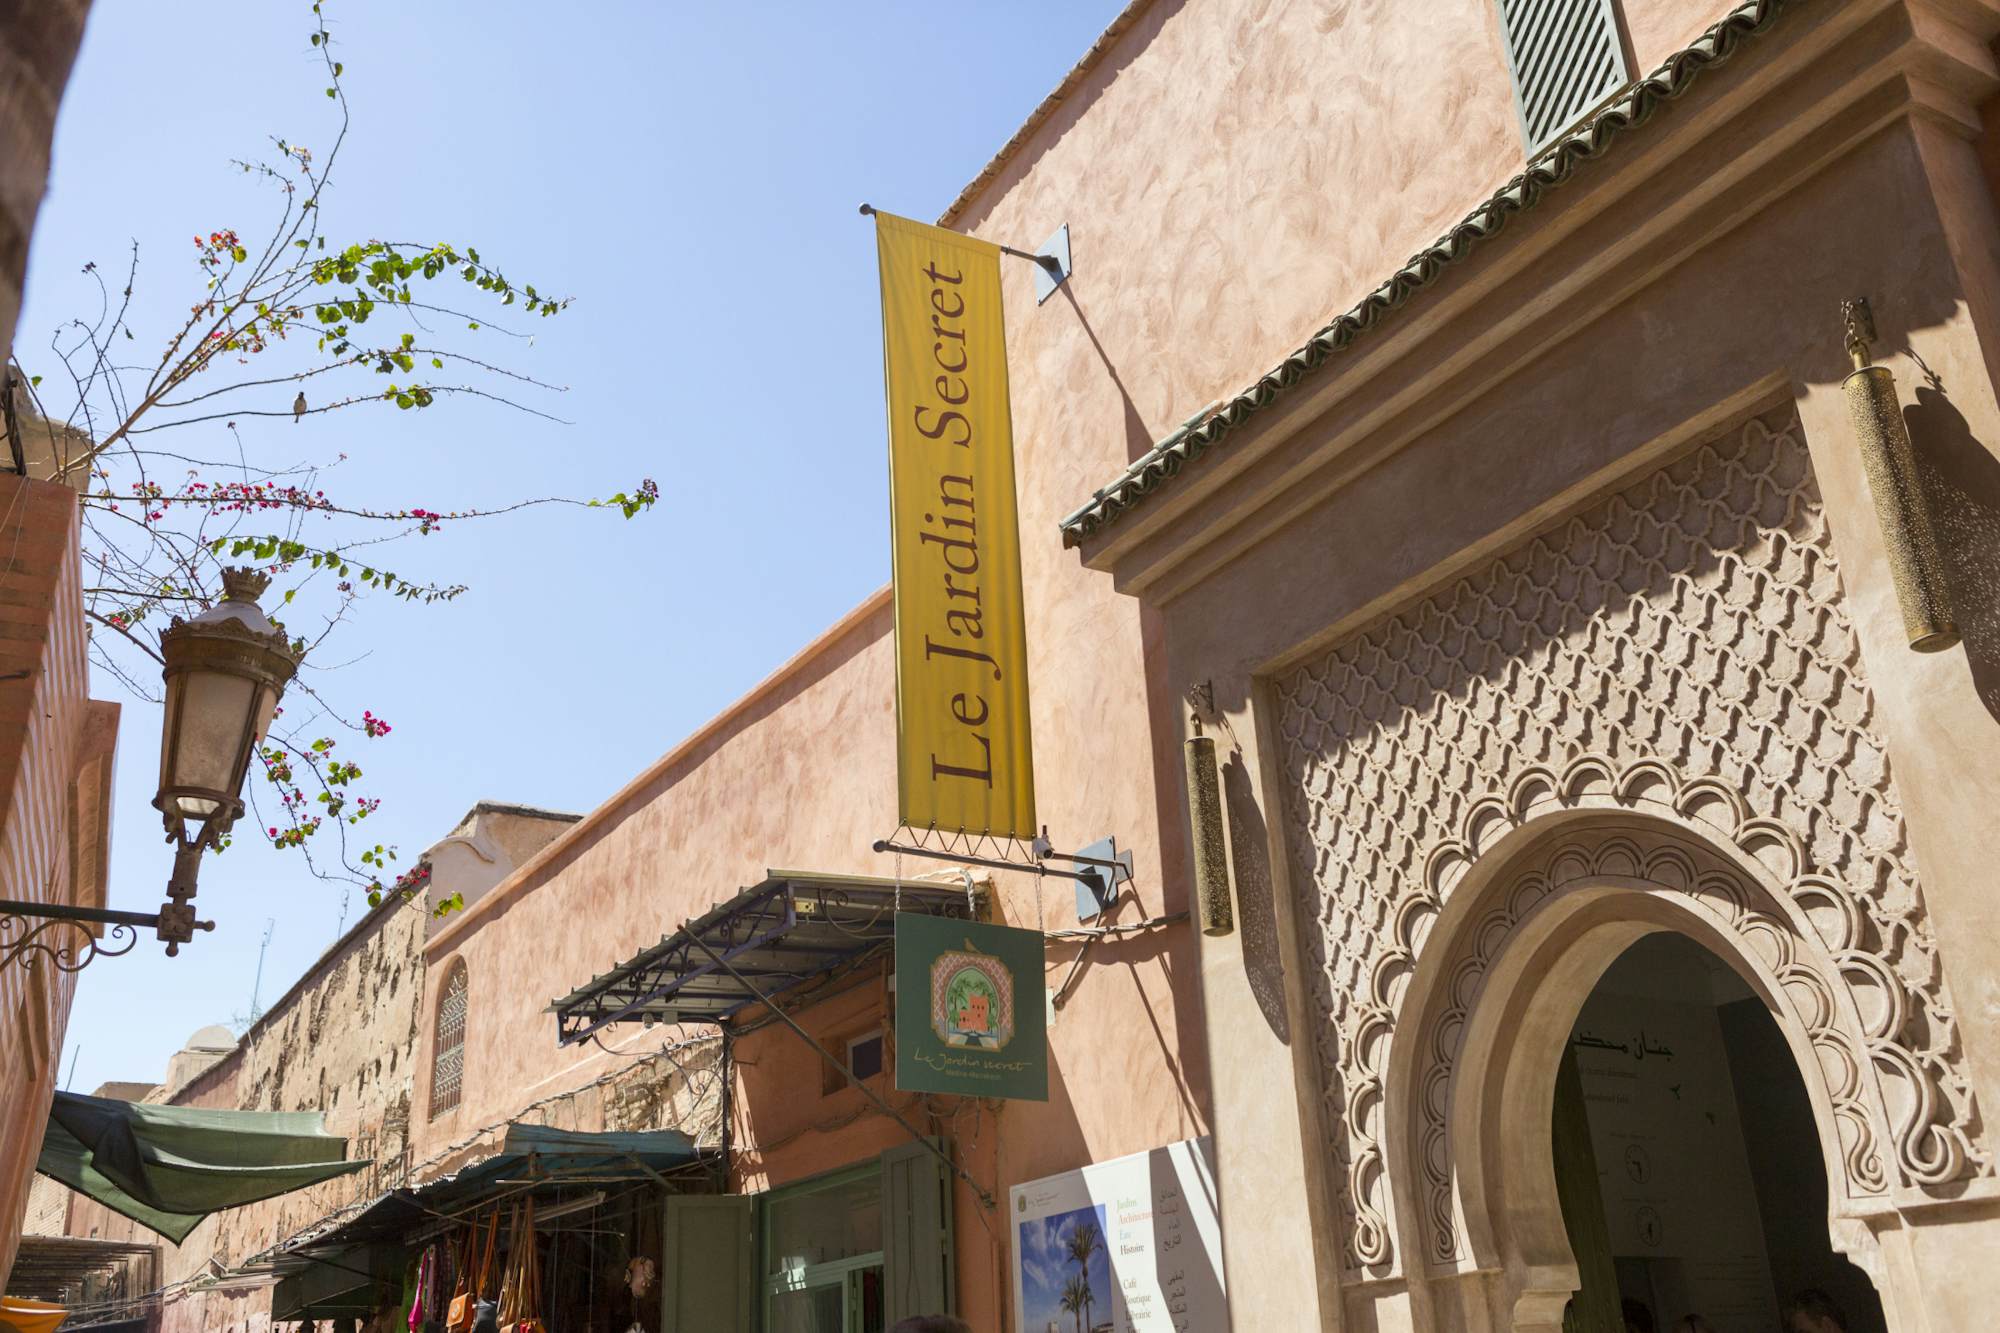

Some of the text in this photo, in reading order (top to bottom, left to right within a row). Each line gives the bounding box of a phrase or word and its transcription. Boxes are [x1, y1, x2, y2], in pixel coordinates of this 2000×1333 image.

[913, 260, 1002, 790] Le Jardin Secret
[928, 1052, 981, 1071] Jardin
[1120, 1244, 1144, 1256] Histoire
[1124, 1294, 1151, 1307] Boutique
